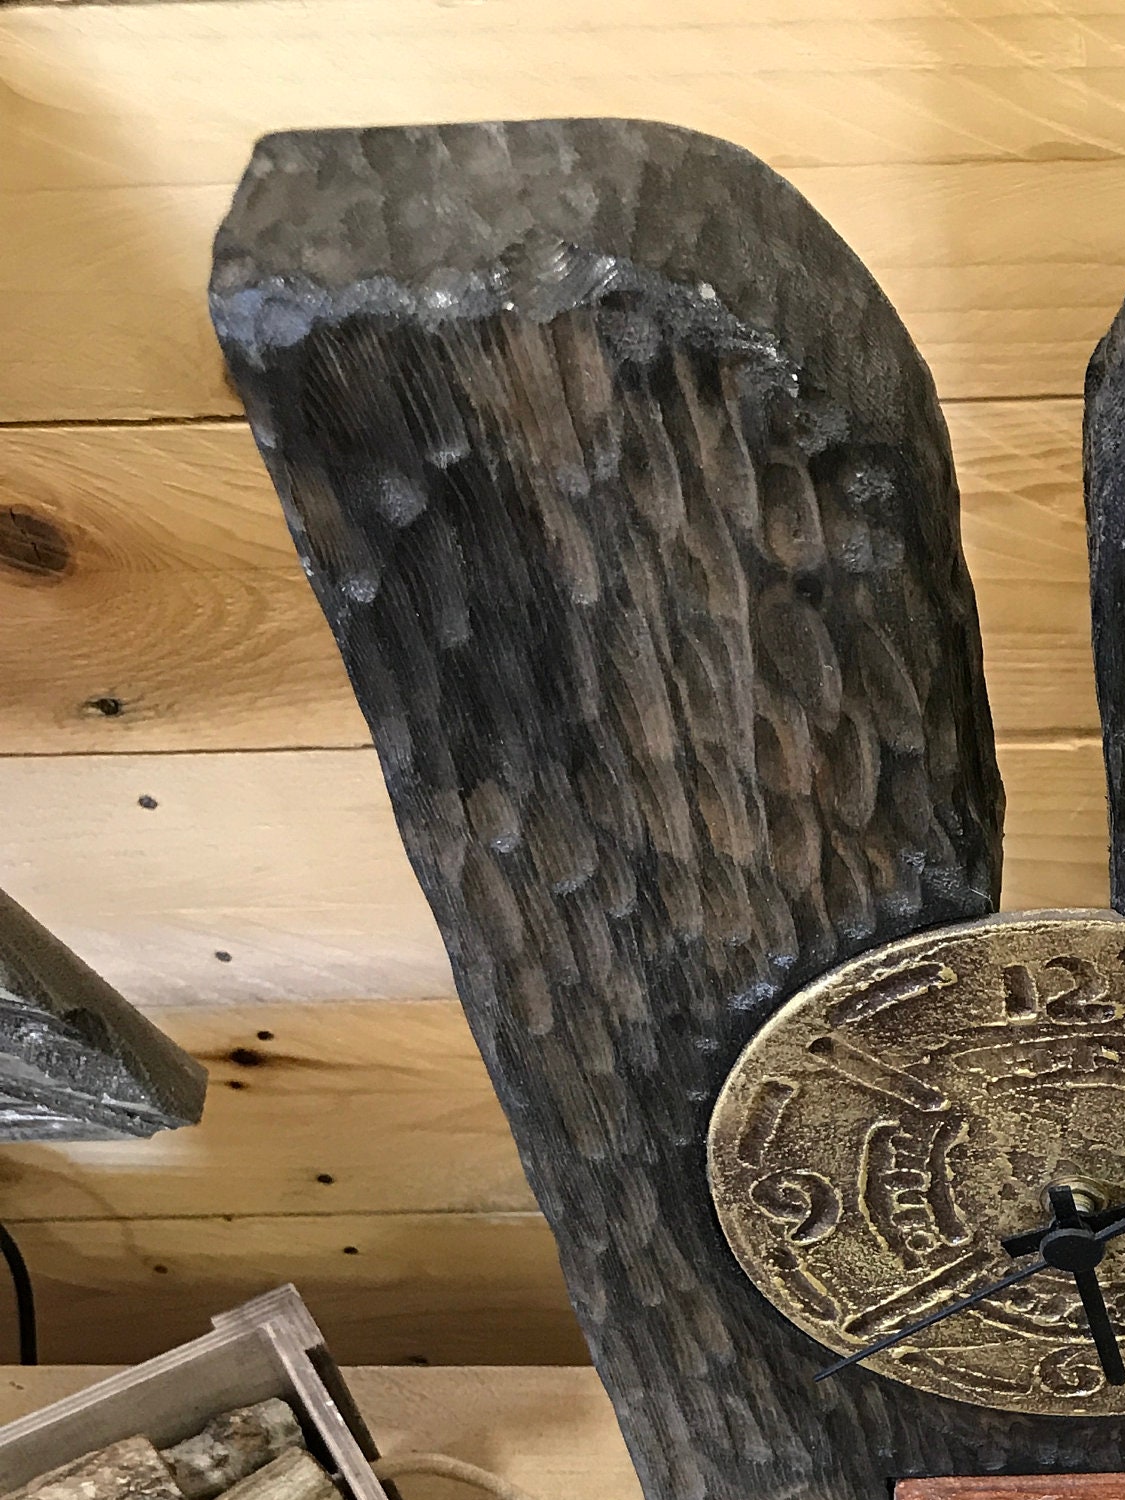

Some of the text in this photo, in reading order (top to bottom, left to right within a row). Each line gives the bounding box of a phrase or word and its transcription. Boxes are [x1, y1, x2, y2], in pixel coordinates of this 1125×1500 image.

[1003, 956, 1120, 1024] 12
[750, 1169, 843, 1245] 9
[1039, 1345, 1106, 1398] 6
